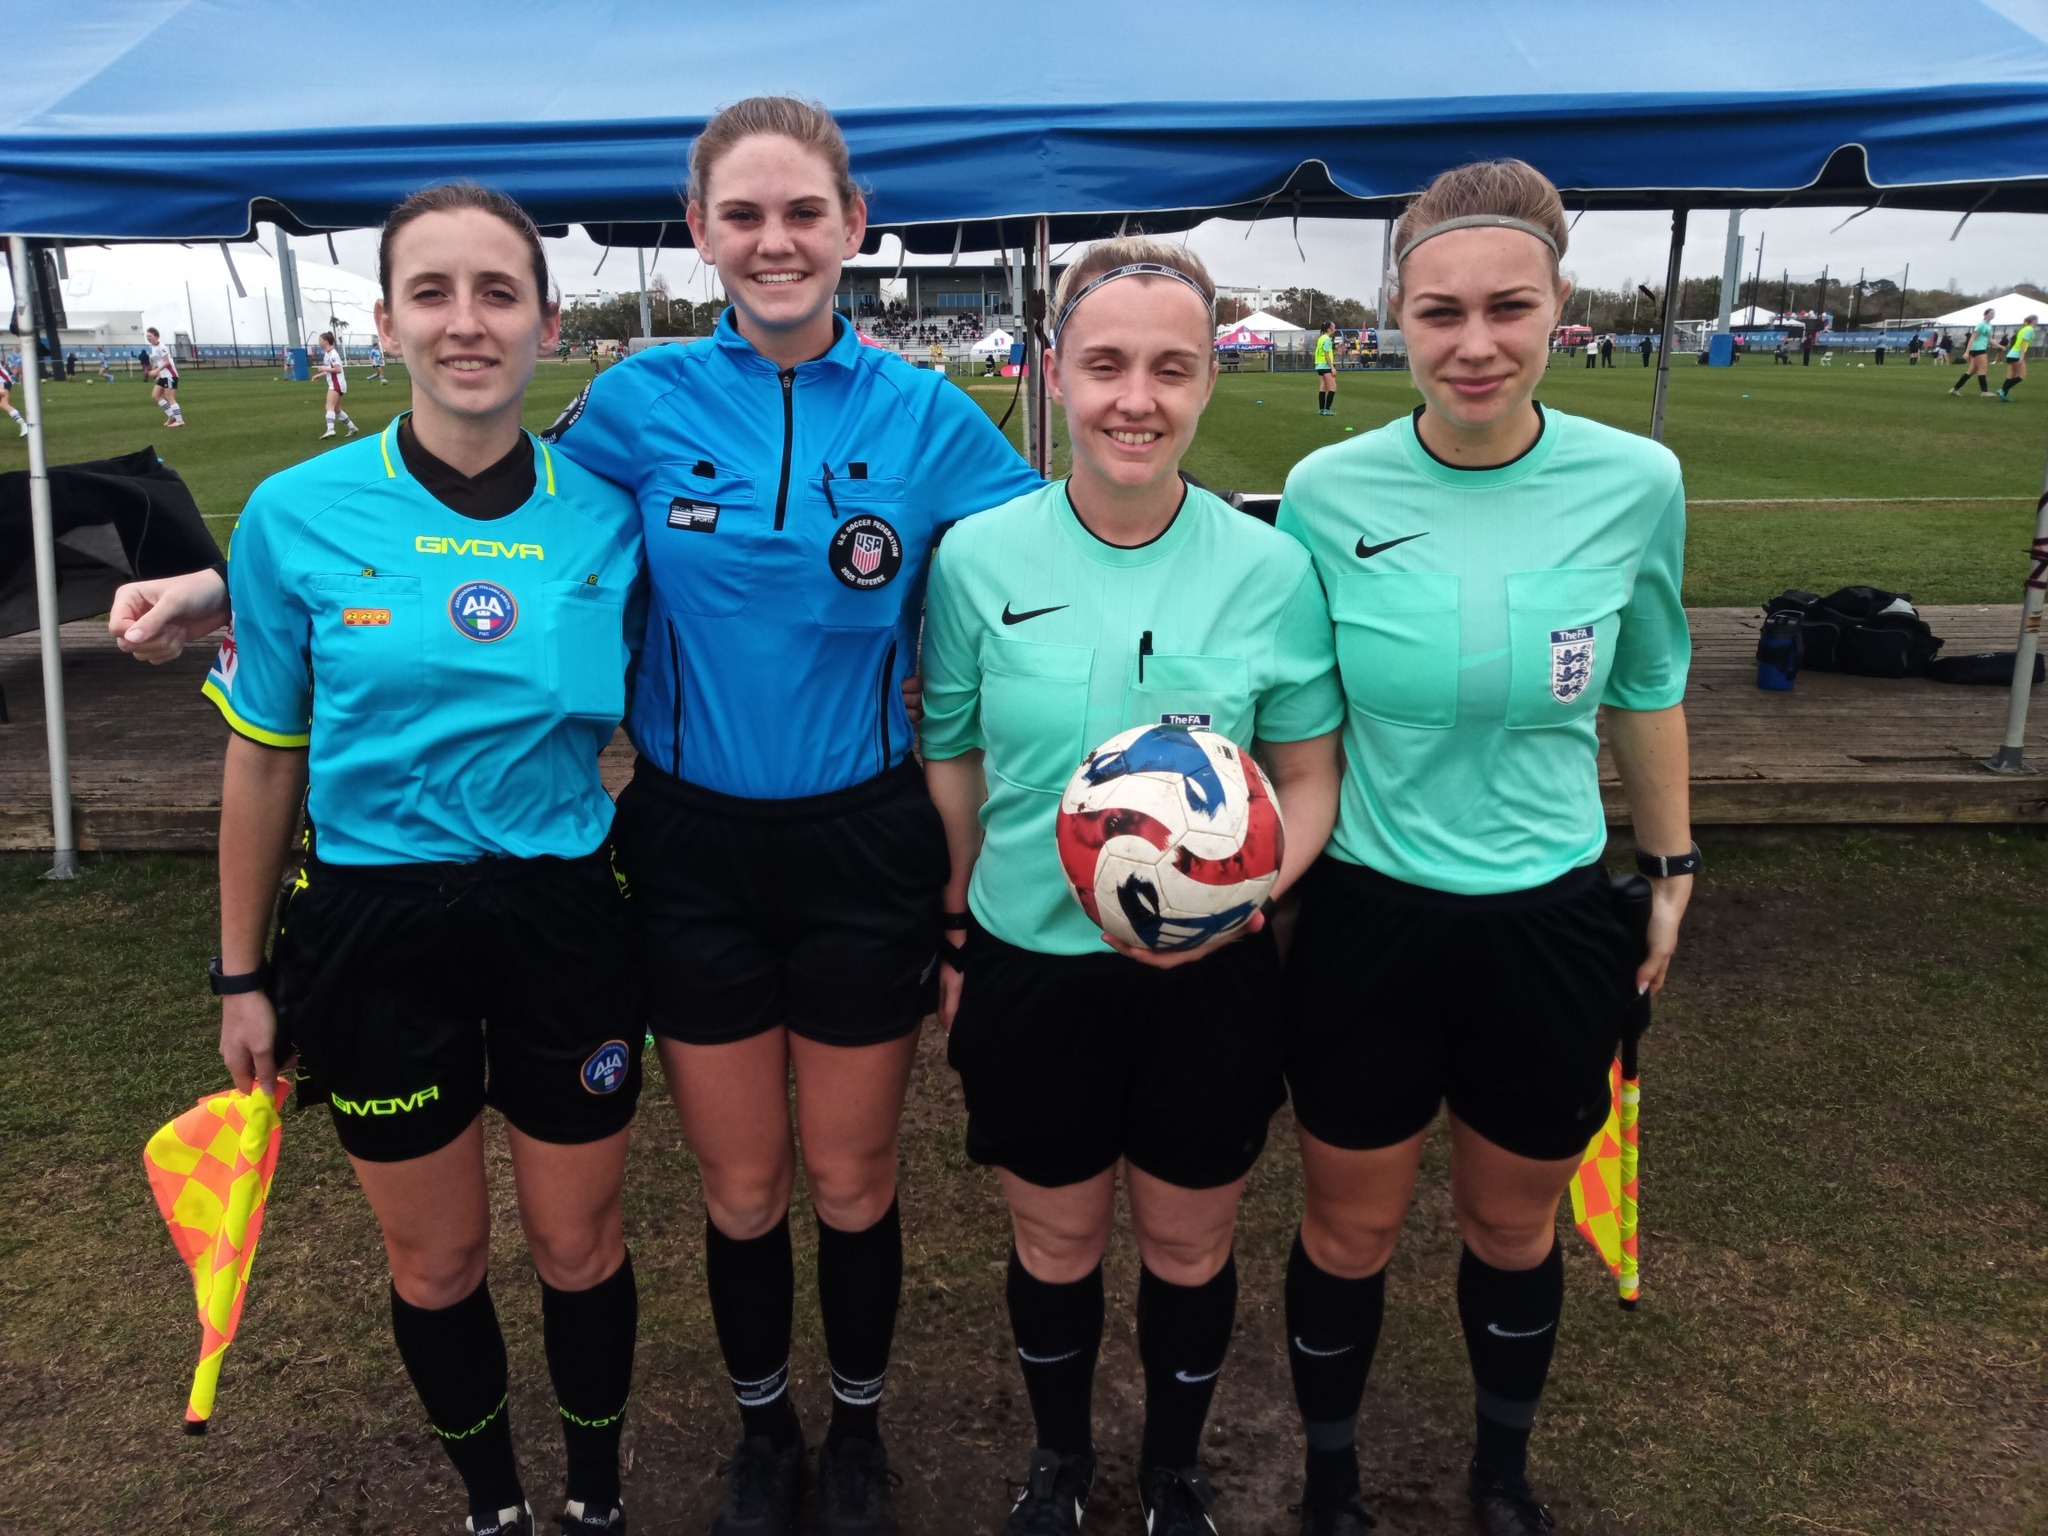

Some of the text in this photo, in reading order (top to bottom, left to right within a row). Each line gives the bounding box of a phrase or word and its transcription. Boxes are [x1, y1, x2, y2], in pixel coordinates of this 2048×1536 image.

[415, 535, 544, 561] GIVOVA
[837, 519, 899, 557] U.S. SOCCER FEDERATION
[856, 533, 882, 552] USA
[840, 567, 886, 586] 2025 REFEREE
[462, 595, 505, 617] AIA
[592, 1053, 623, 1080] AIA
[331, 1086, 439, 1116] GIVOVA
